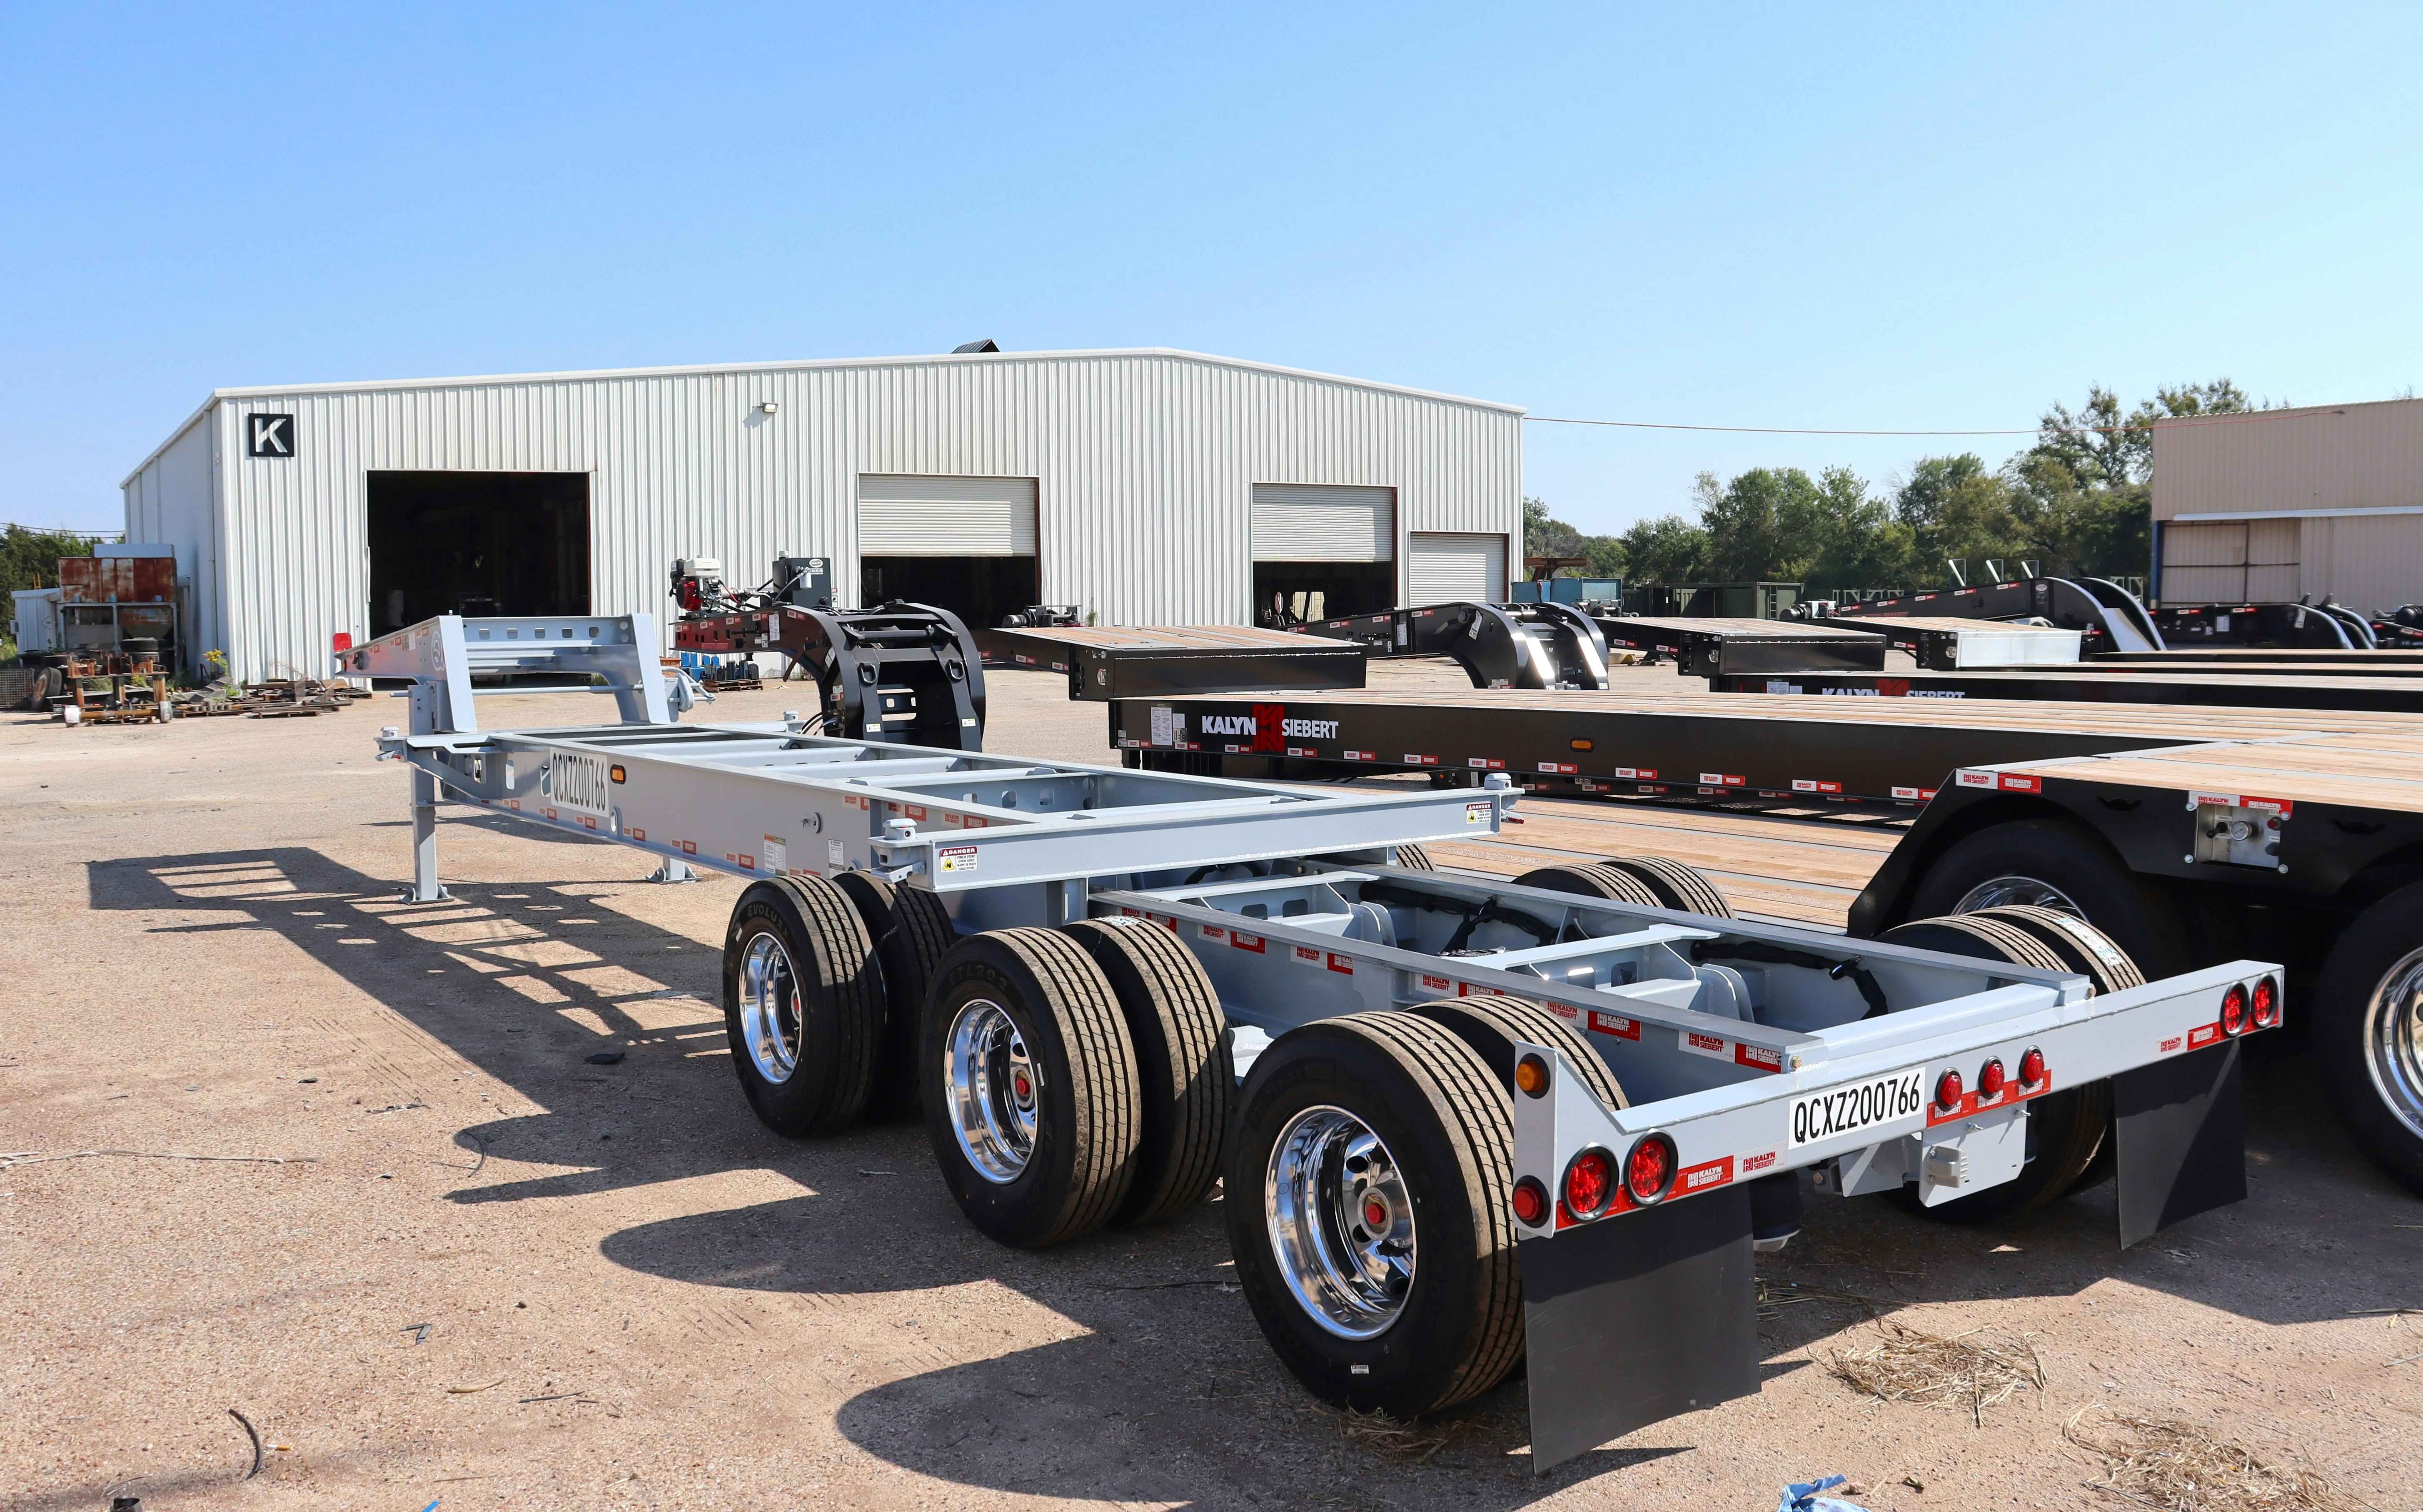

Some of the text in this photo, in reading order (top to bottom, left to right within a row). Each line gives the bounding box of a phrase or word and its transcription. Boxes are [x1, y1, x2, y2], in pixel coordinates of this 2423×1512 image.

[255, 418, 288, 453] K
[1202, 716, 1256, 735] KALYN
[1282, 719, 1339, 739] SIEBERT
[553, 752, 606, 811] QCXZ200766
[1432, 977, 1450, 986] KALYN
[1475, 986, 1495, 996] KALYN
[1557, 1004, 1578, 1015] KALYN
[1557, 1010, 1578, 1020] SIEBERT
[1607, 1015, 1629, 1025] KALYN
[1607, 1021, 1629, 1032] SIEBERT
[1700, 1035, 1724, 1047] KALYN
[1700, 1042, 1724, 1052] SIEBERT
[1794, 1073, 1921, 1143] QCXZ200766
[1754, 1152, 1775, 1163] KALYN
[1754, 1158, 1776, 1170] SIEBERT
[1699, 1165, 1722, 1178] KALYN
[1699, 1173, 1722, 1185] SIEBERT
